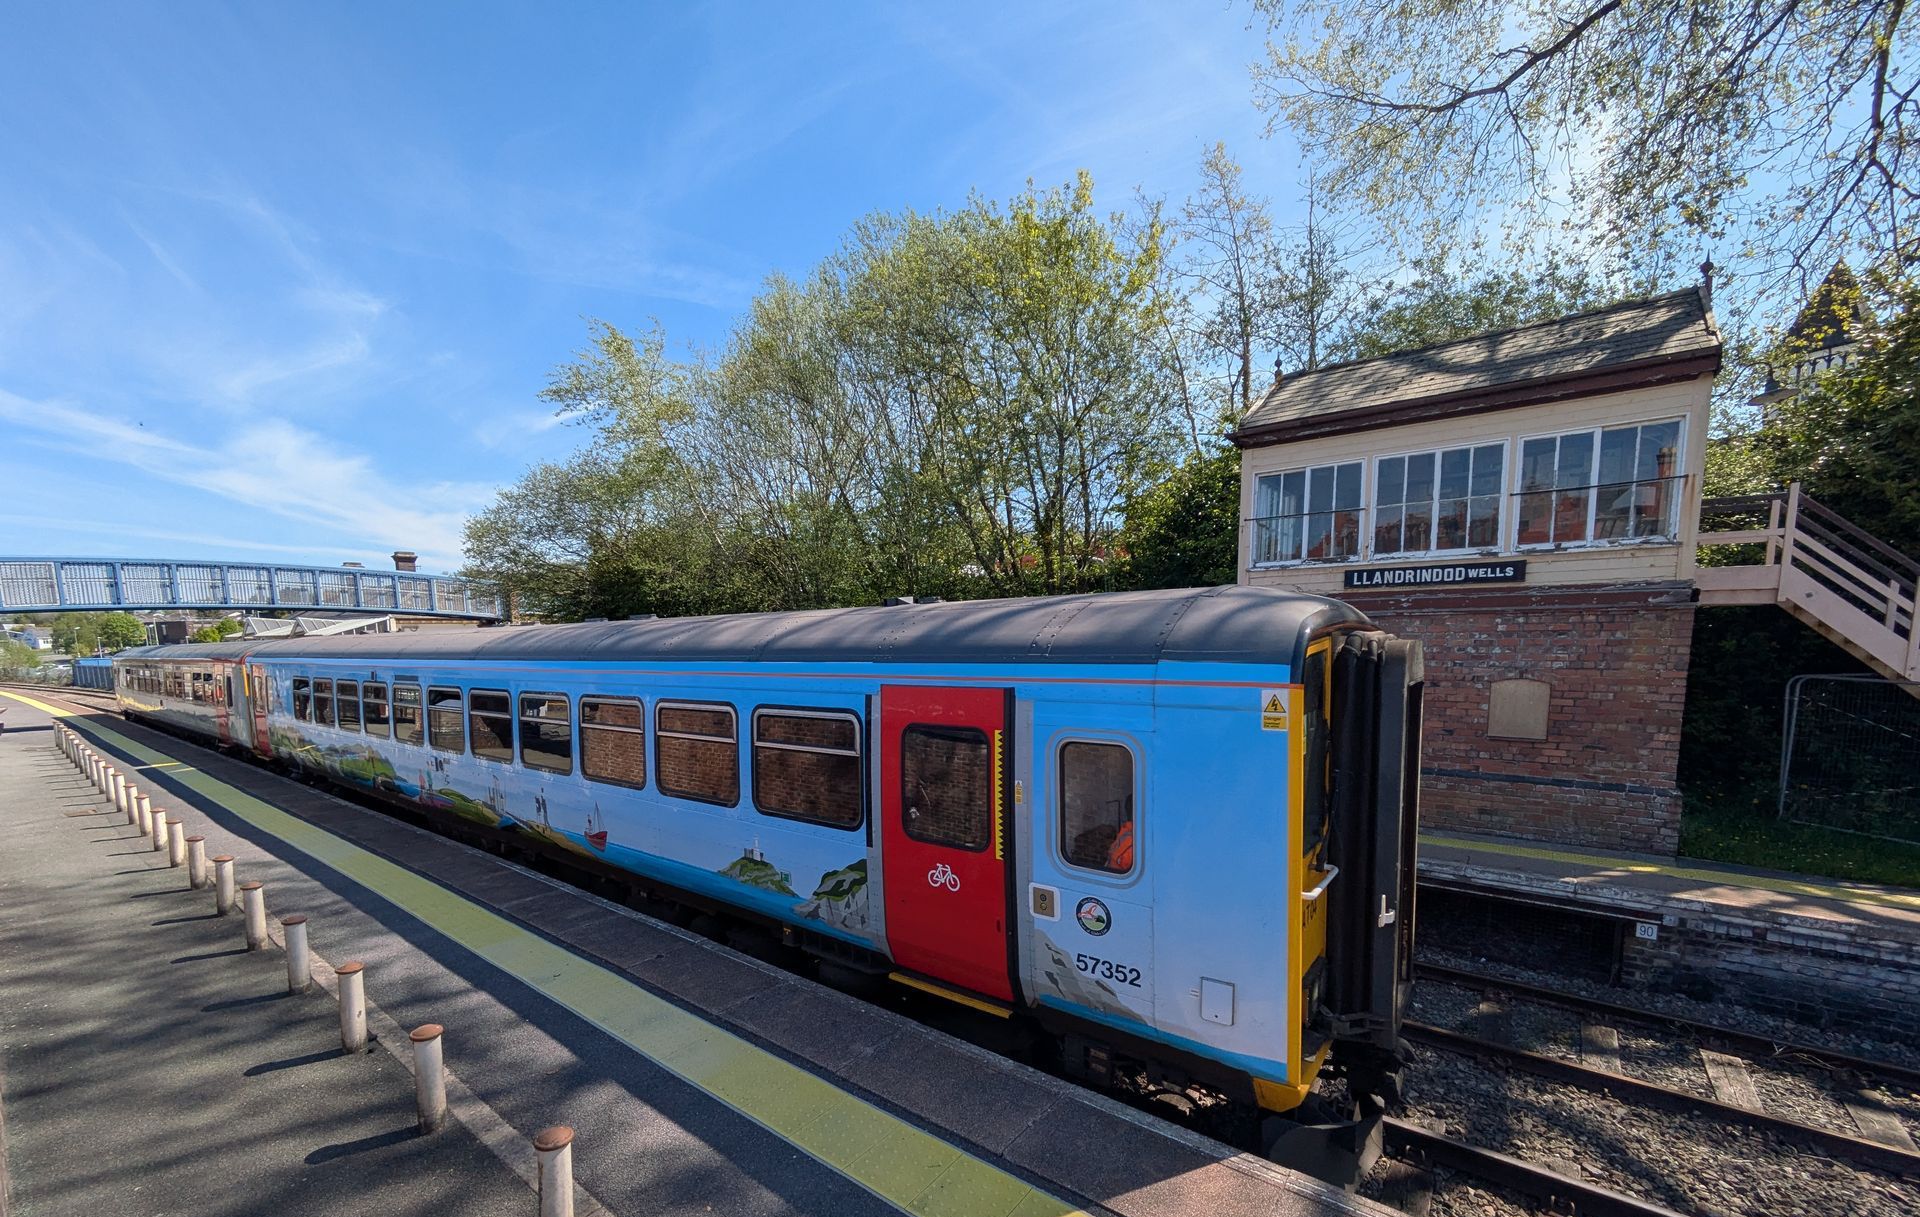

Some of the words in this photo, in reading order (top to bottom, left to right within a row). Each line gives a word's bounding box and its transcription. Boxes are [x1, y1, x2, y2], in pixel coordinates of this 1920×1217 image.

[1353, 567, 1465, 585] LLANDRINDOD
[1468, 566, 1514, 579] WELLS
[1639, 925, 1654, 937] 90
[1076, 953, 1142, 988] 57352
